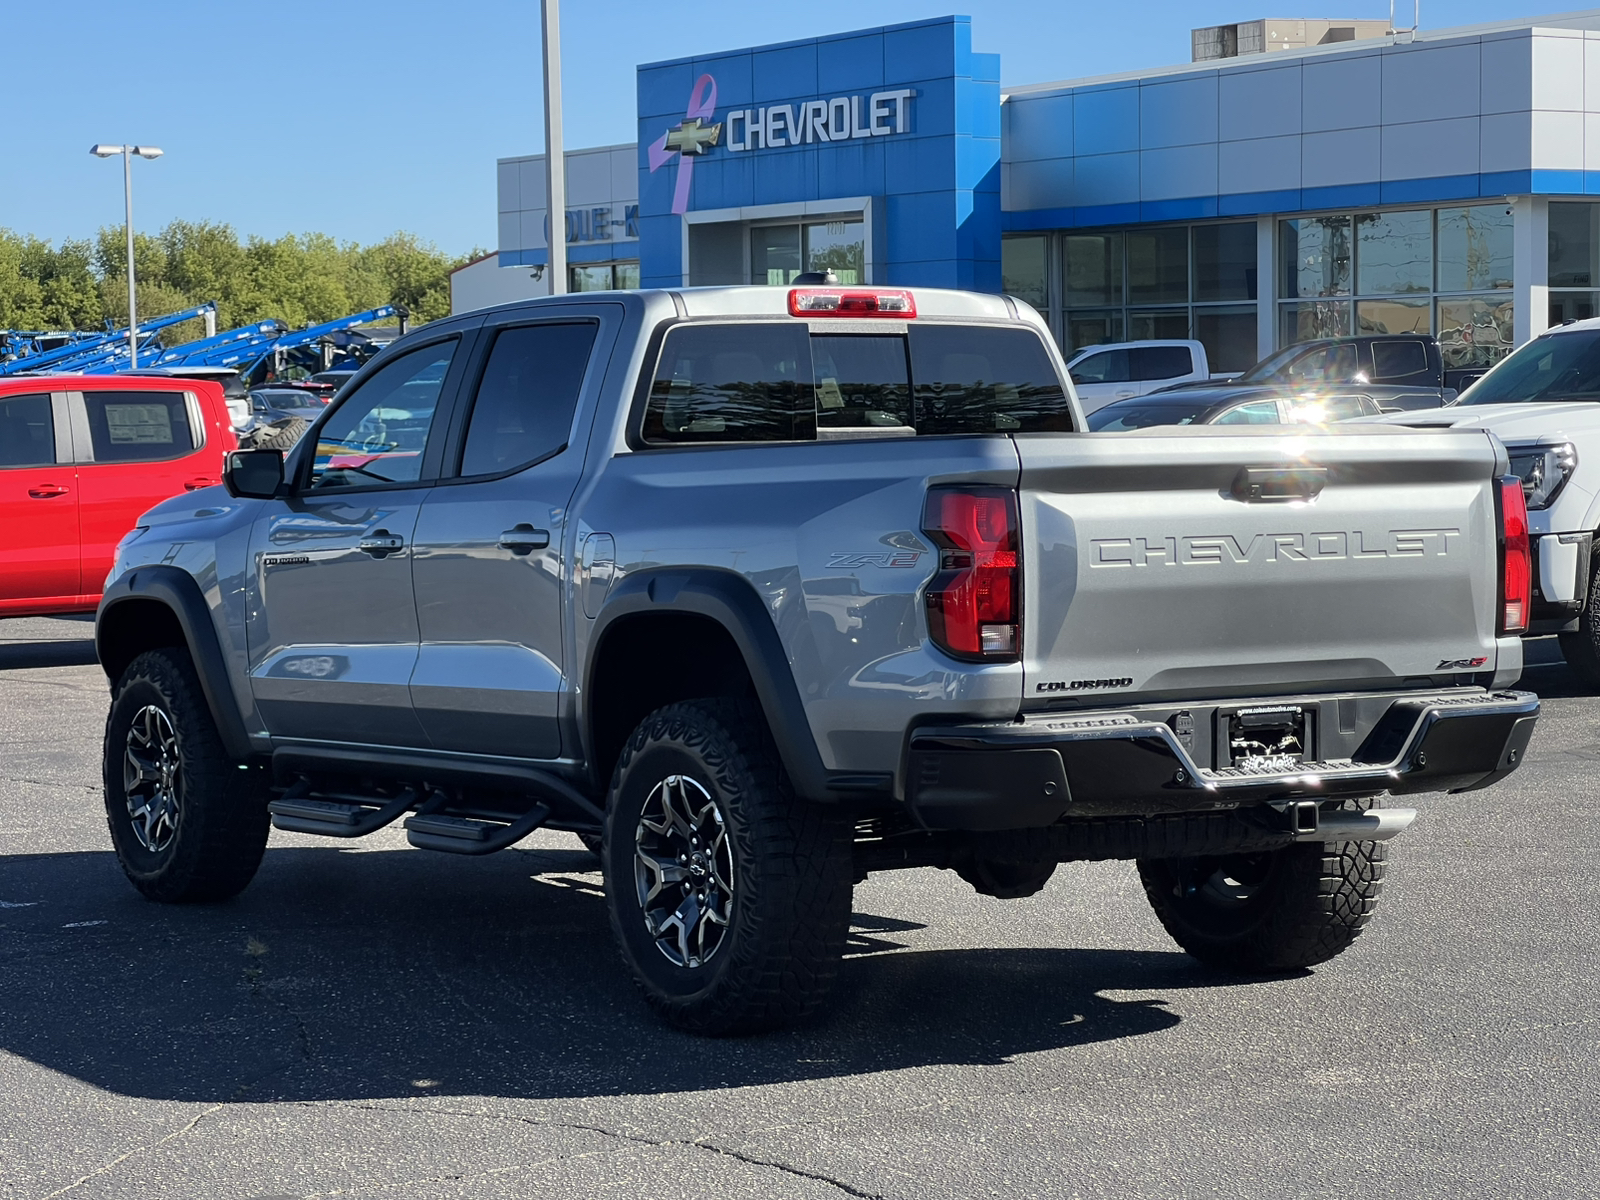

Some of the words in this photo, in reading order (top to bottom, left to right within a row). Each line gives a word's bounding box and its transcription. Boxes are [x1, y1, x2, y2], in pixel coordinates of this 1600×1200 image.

[727, 89, 911, 152] CHEVROLET
[1090, 528, 1460, 568] CHEVROLET
[825, 550, 921, 569] ZR2
[1435, 657, 1488, 671] ZR2
[1036, 677, 1133, 693] COLORADO
